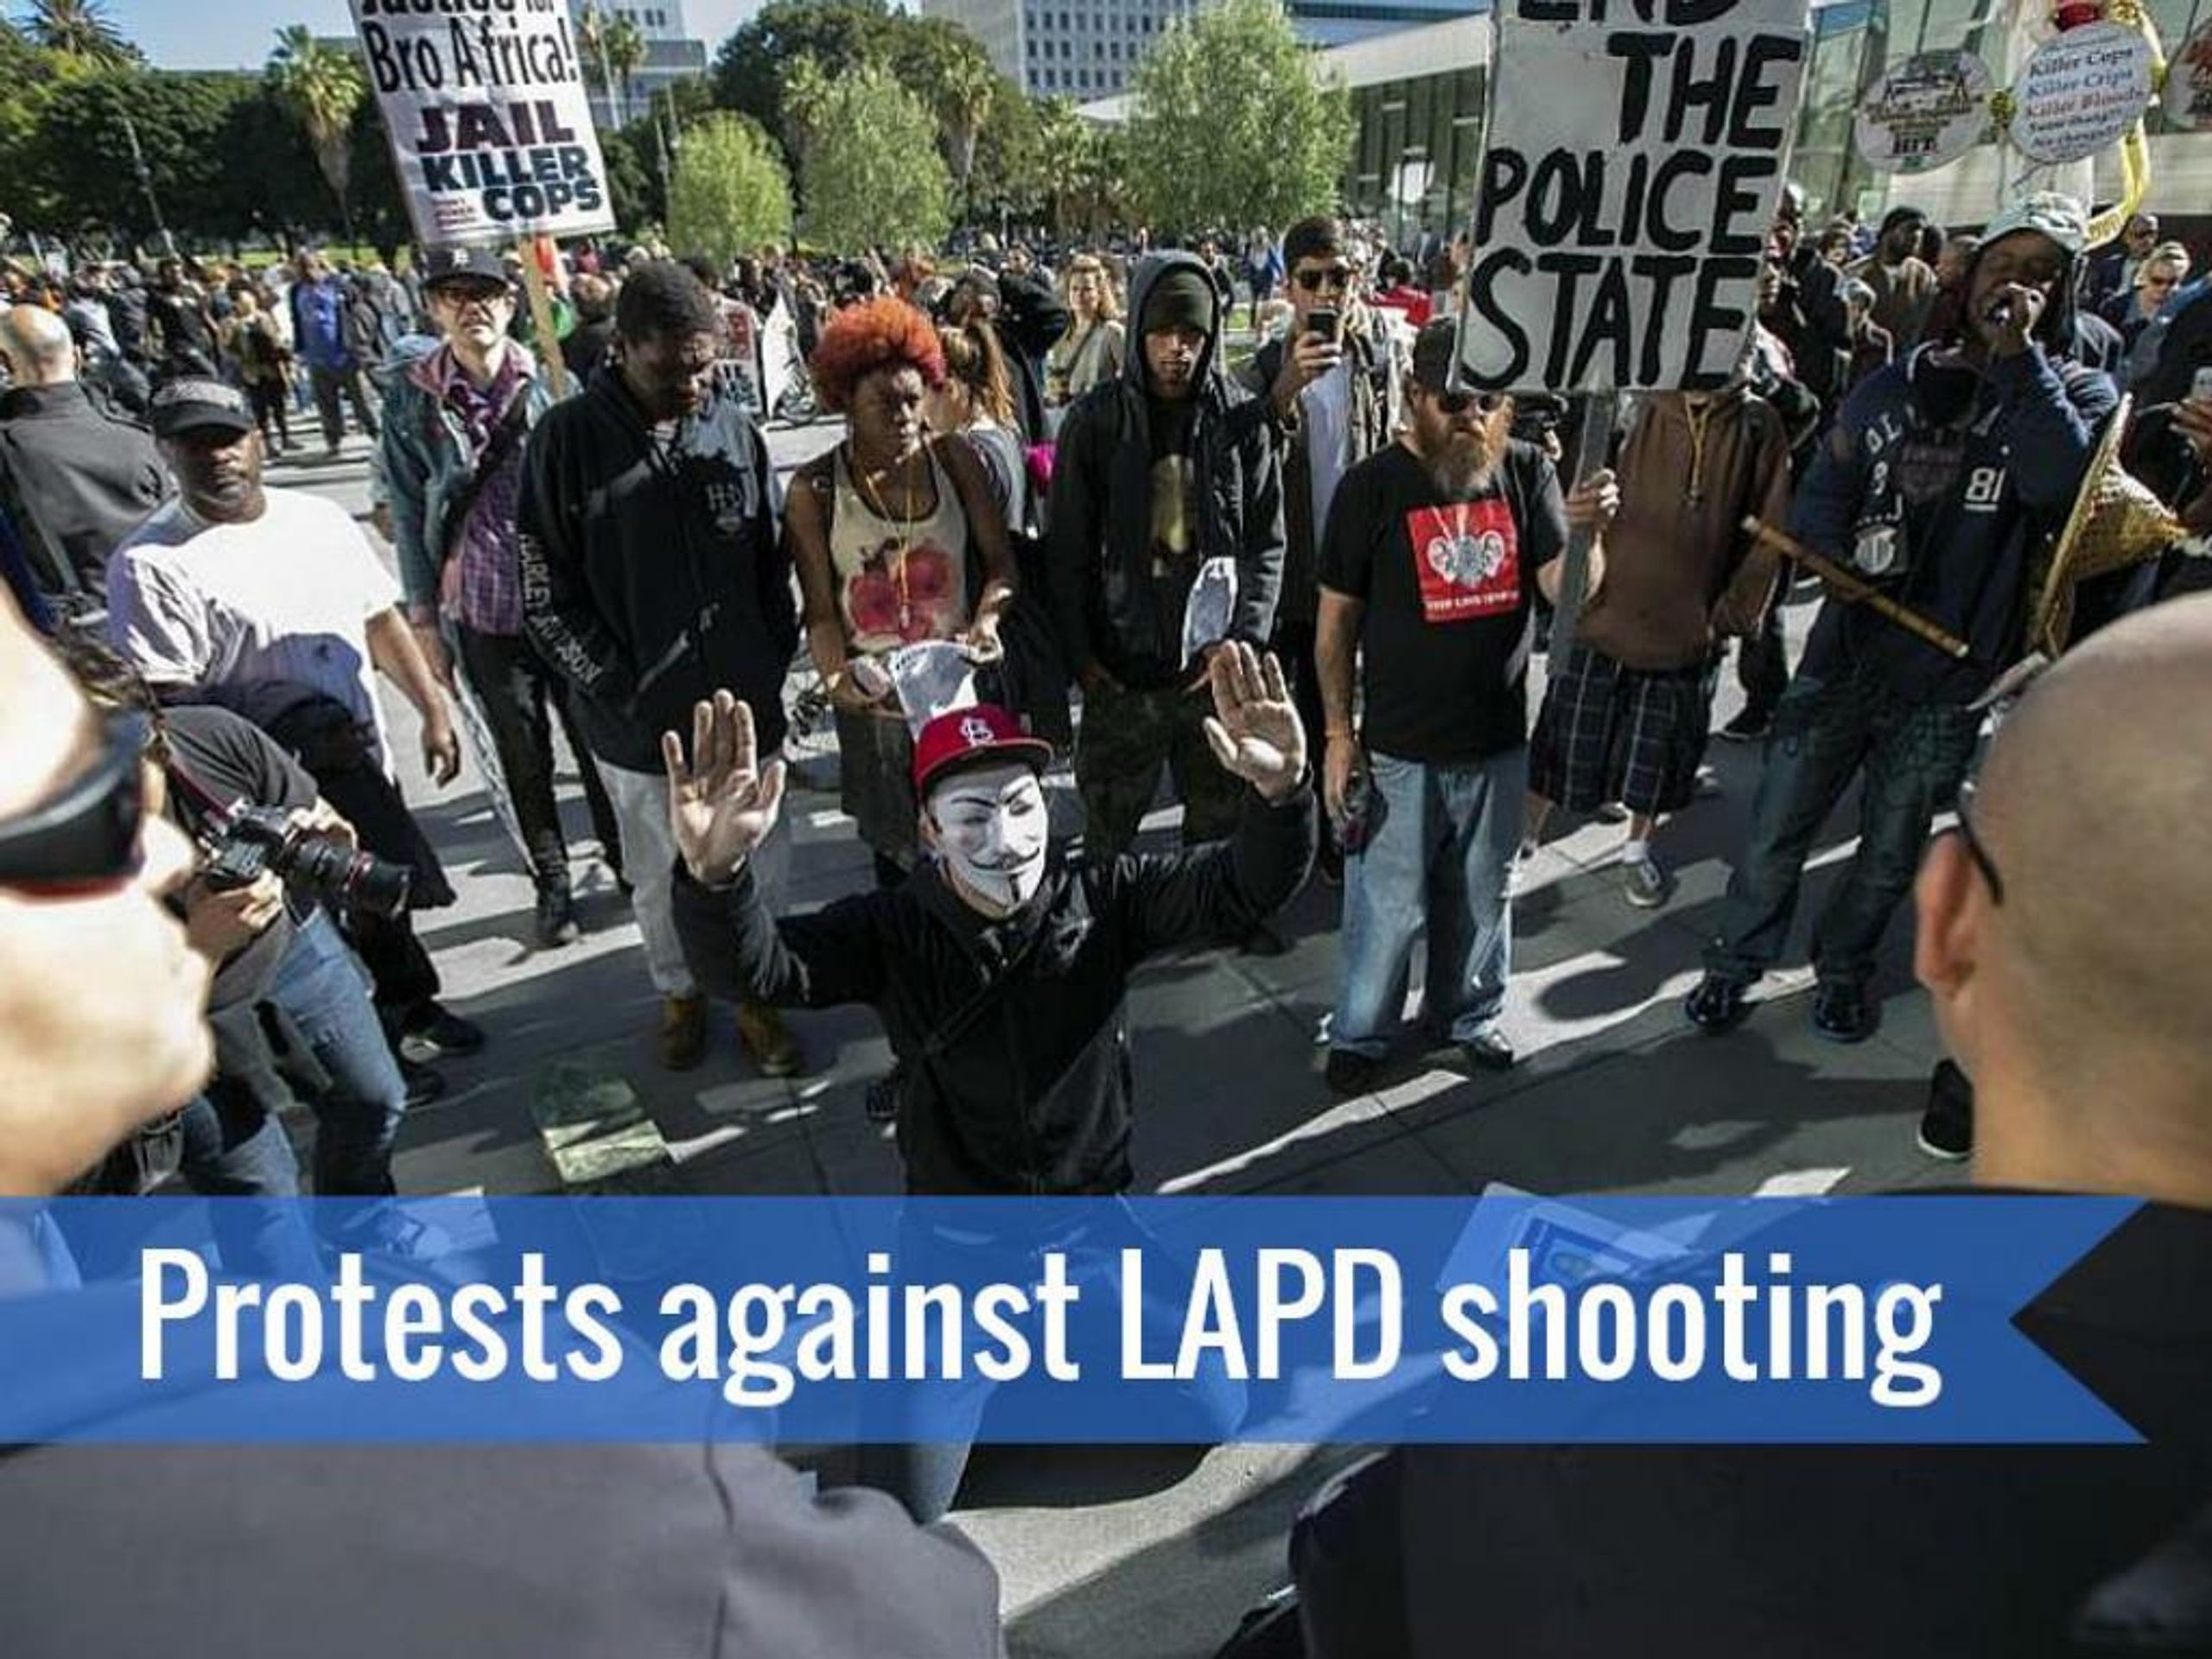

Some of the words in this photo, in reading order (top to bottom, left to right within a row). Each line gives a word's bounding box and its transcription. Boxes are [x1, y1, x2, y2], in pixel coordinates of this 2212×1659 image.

[361, 21, 442, 92] Bro
[448, 16, 578, 87] Africa!
[1606, 32, 1802, 149] THE
[415, 100, 575, 153] JAIL
[419, 145, 589, 193] KILLER
[481, 178, 602, 222] COPS
[1472, 146, 1778, 255] POLICE
[1461, 247, 1759, 391] STATE
[1963, 467, 2007, 503] 81
